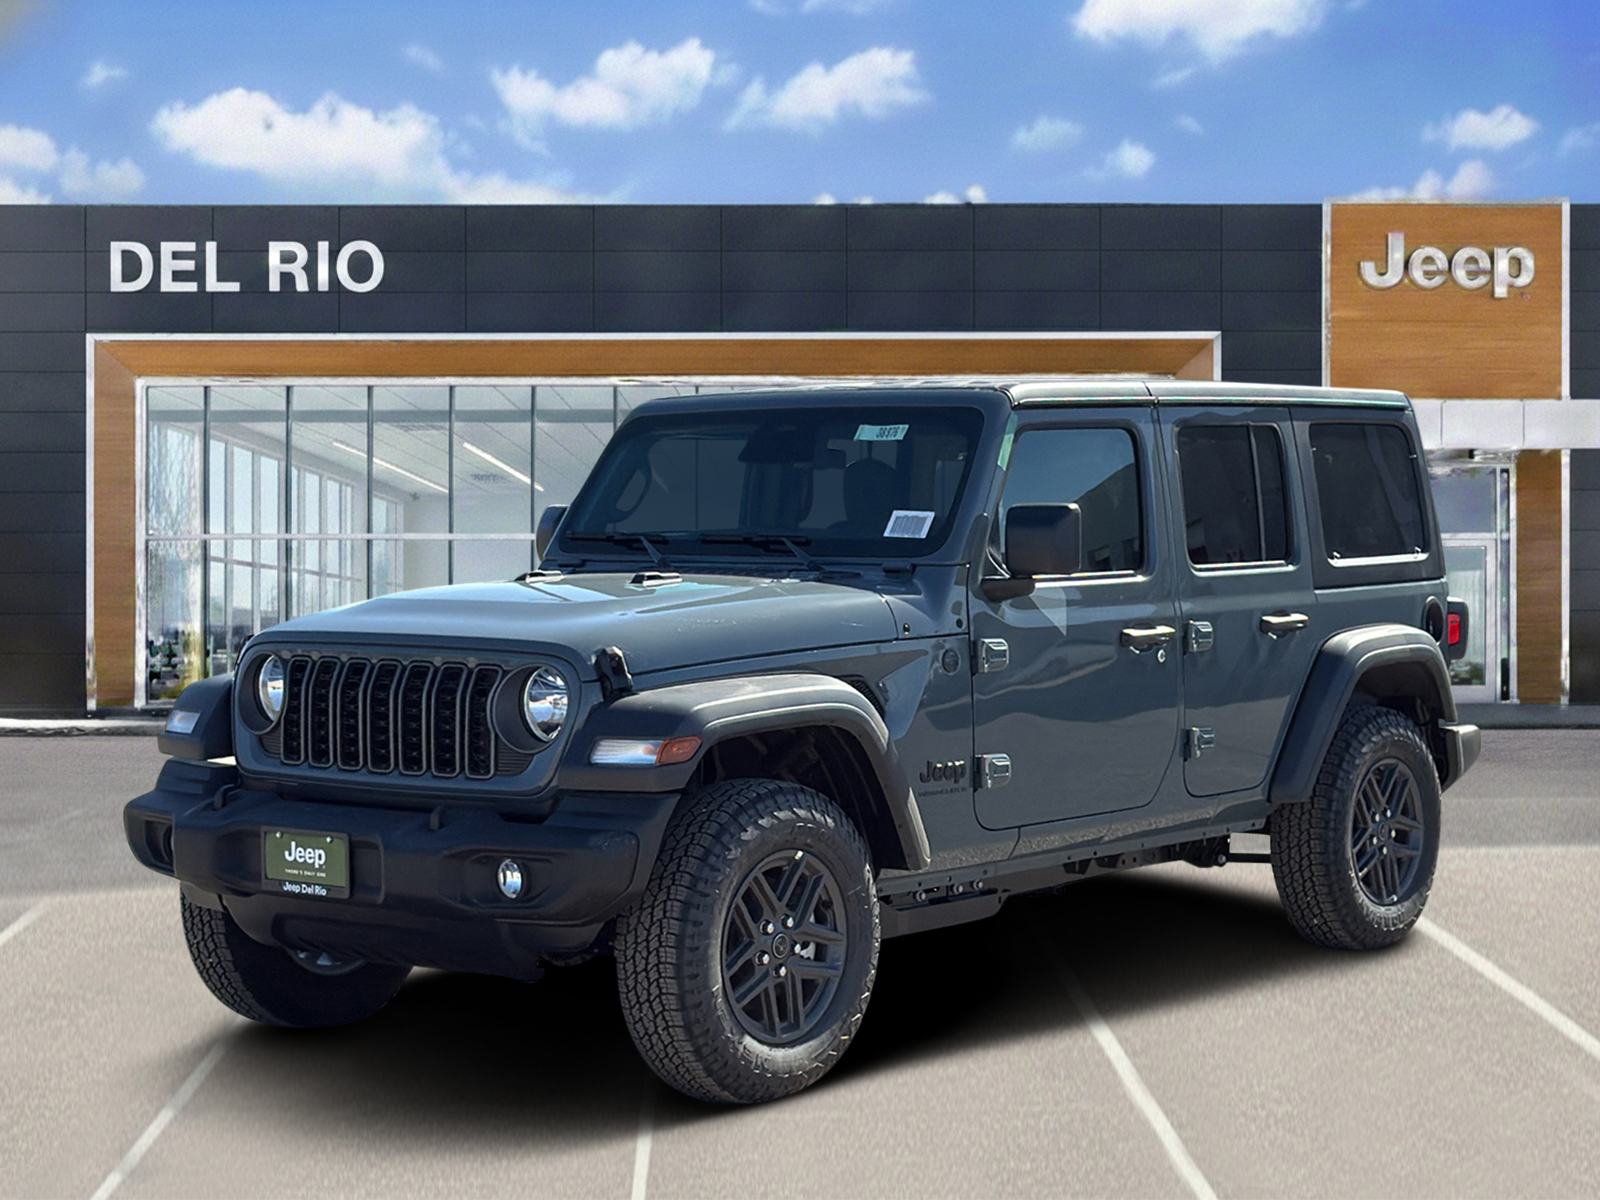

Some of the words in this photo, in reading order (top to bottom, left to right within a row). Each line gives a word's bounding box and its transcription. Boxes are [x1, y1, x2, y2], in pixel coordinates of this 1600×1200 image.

[110, 241, 241, 293] DEL
[268, 240, 385, 293] RIO
[1359, 231, 1535, 299] Jeep
[919, 760, 967, 785] Jeep
[284, 841, 326, 869] Jeep
[283, 881, 301, 893] Jeep
[301, 883, 314, 895] Del
[314, 884, 327, 896] Rio
